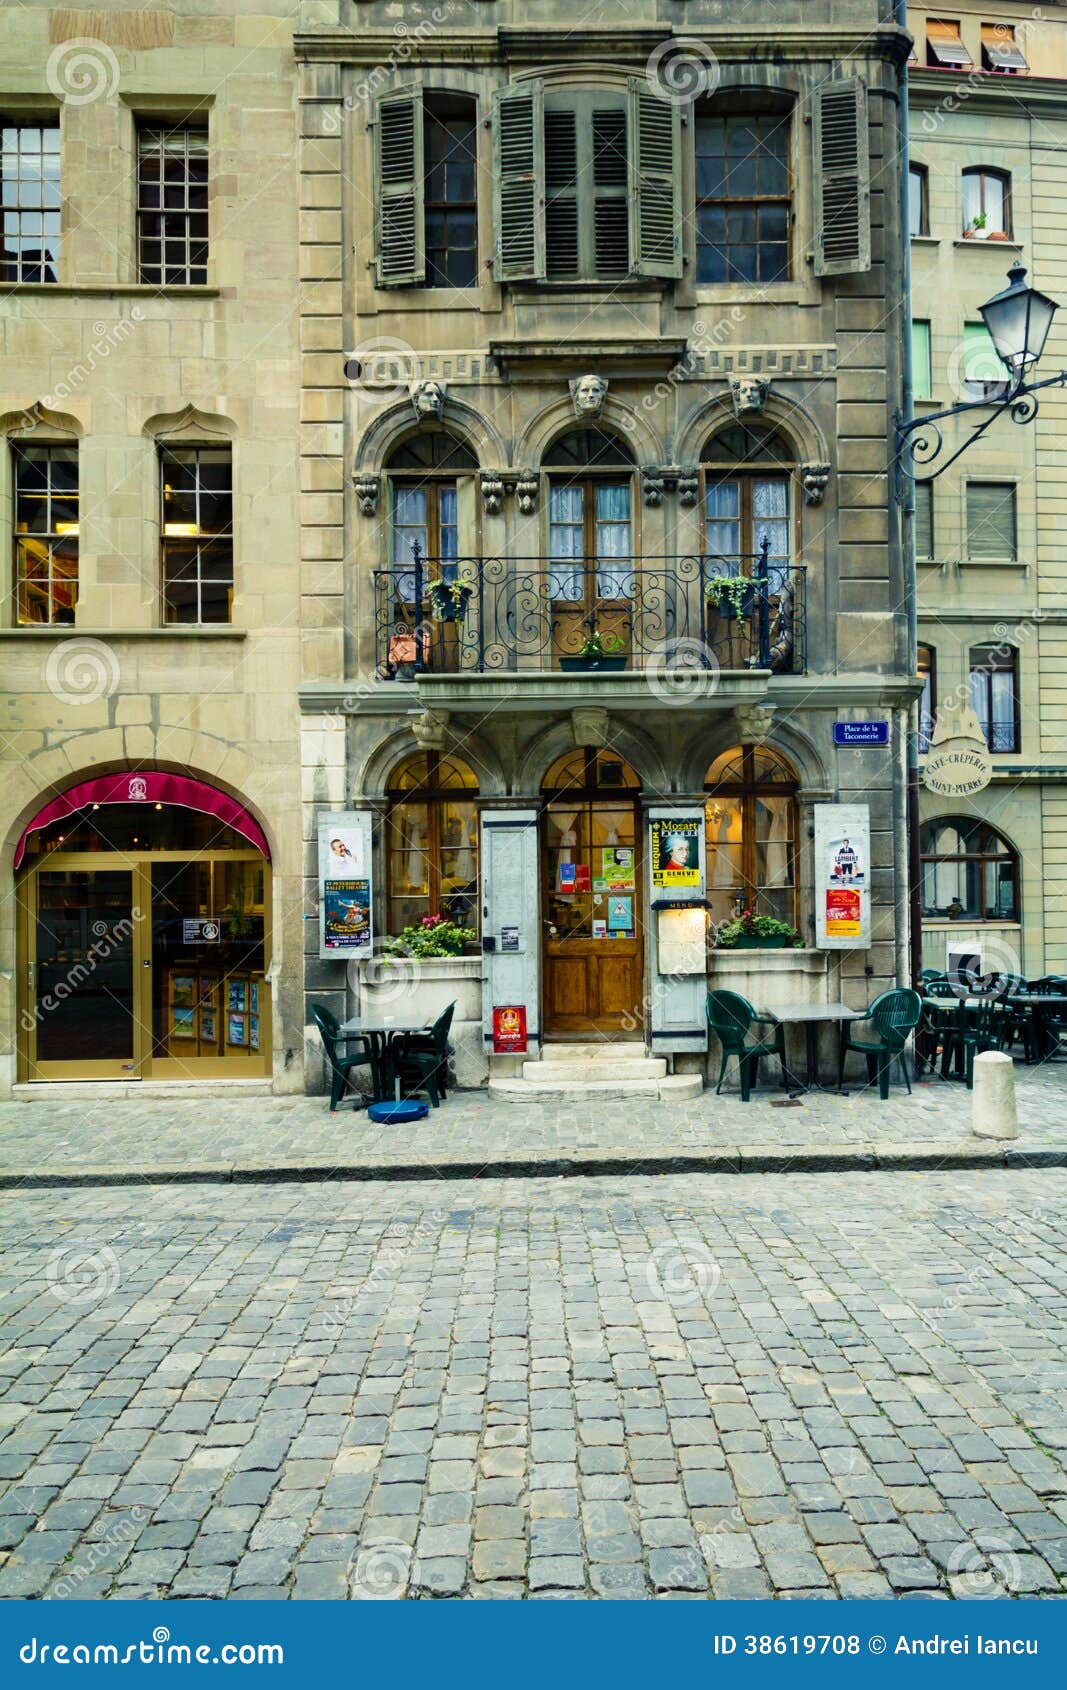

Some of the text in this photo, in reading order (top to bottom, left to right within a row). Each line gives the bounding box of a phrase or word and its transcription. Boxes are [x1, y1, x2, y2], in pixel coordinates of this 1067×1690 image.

[844, 724, 878, 732] Place de la
[843, 732, 879, 740] Taconnerie
[661, 820, 698, 831] Mozart
[652, 832, 661, 870] REQUIEM
